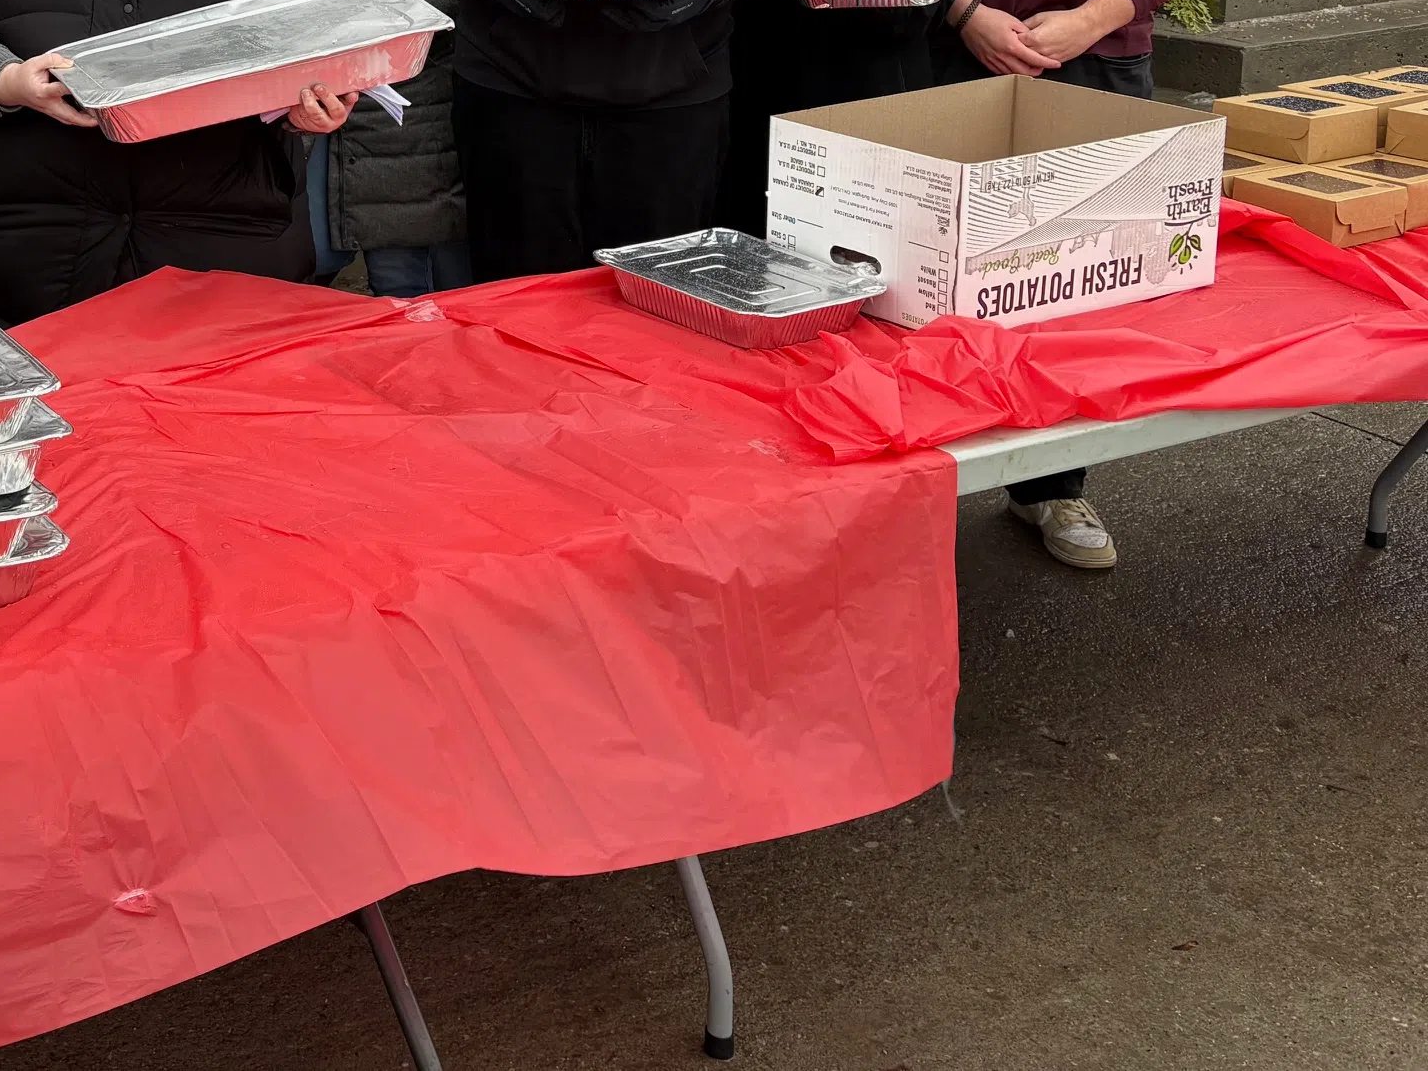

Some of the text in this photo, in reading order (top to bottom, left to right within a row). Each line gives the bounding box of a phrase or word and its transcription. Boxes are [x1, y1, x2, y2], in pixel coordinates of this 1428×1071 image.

[1167, 178, 1214, 202] Fresh
[1166, 197, 1212, 220] Earth
[920, 265, 937, 277] White
[917, 276, 937, 288] Russet
[976, 254, 1143, 320] FRESH POTATOES
[918, 288, 936, 299] Yellow
[925, 302, 936, 311] Red
